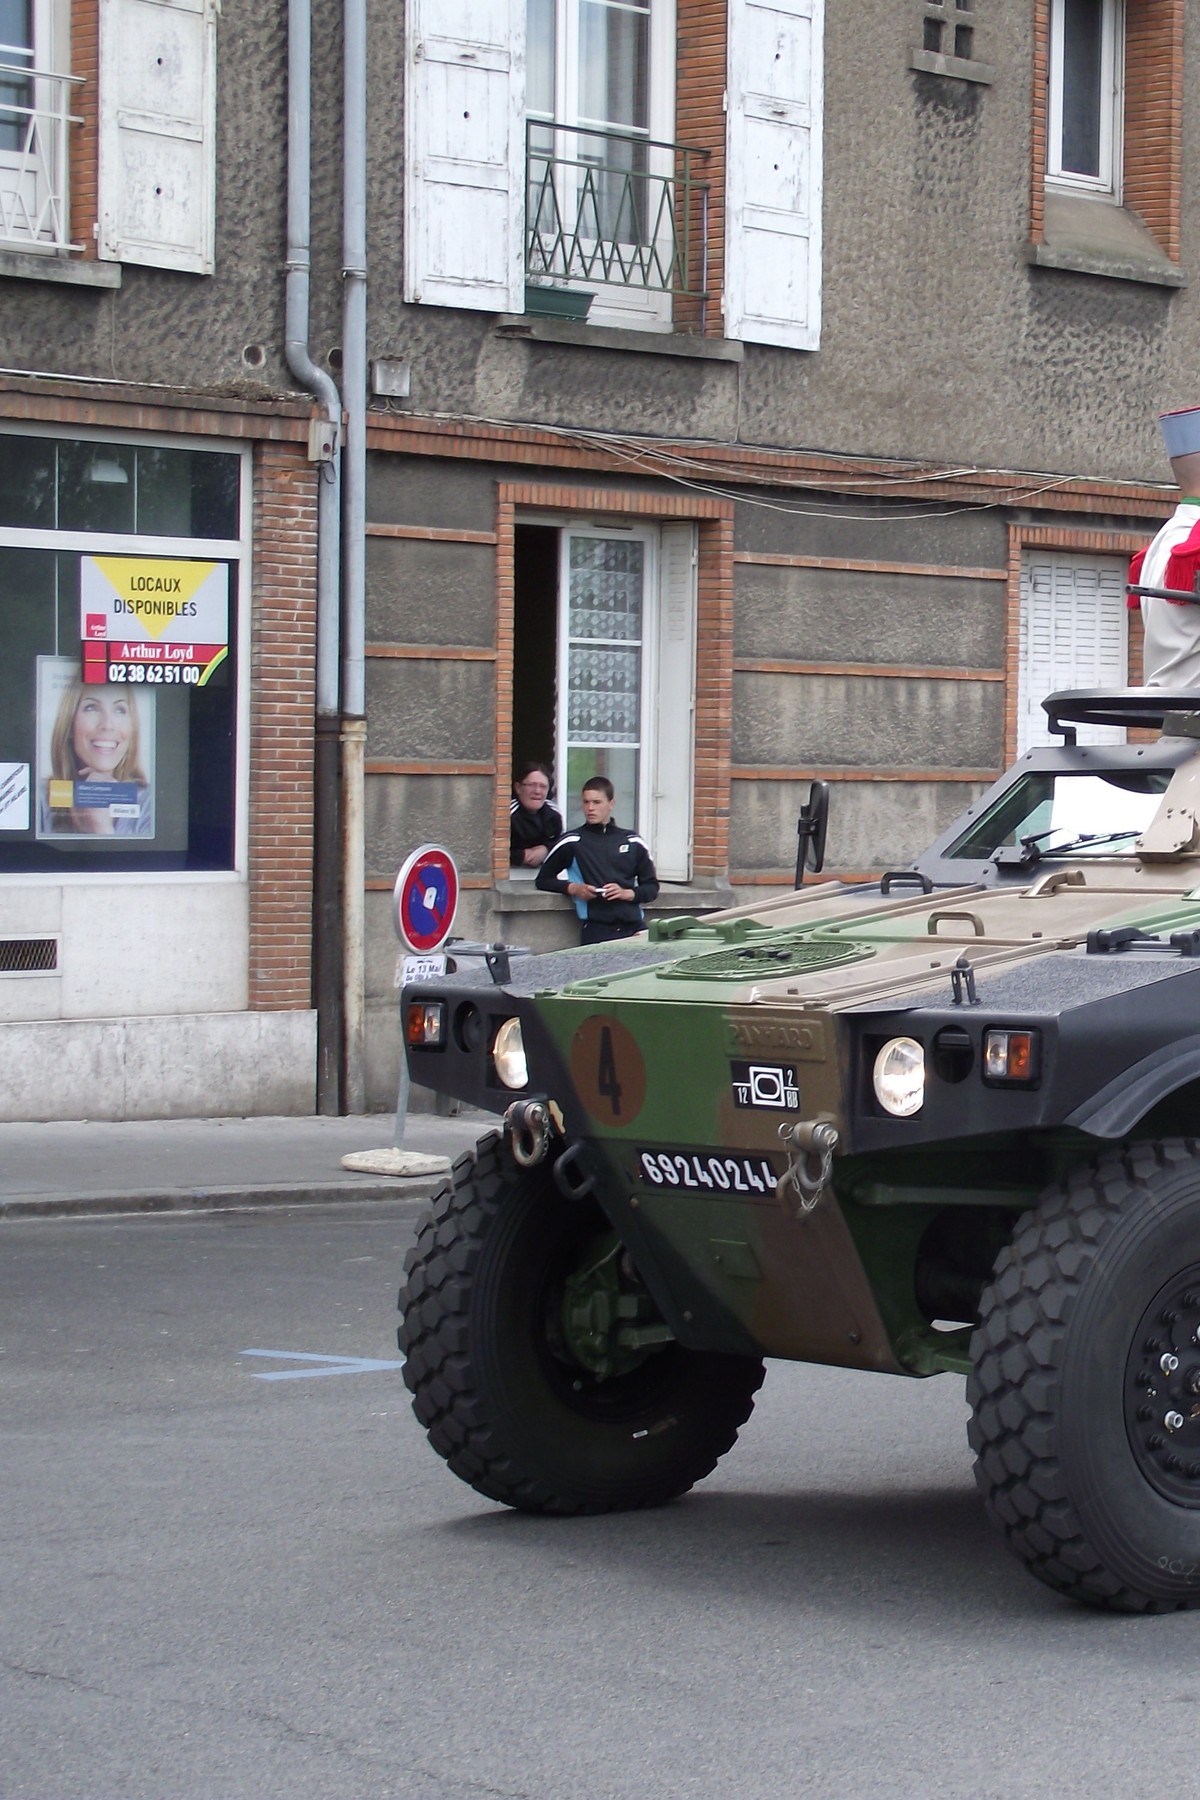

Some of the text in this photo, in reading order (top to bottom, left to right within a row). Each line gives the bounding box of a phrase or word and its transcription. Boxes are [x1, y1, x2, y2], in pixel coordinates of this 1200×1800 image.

[130, 576, 181, 593] LOCAUX
[114, 599, 197, 616] DISPONIBLES
[121, 643, 194, 663] Arthur Loyd
[109, 664, 199, 684] 02 38 62 51 00
[599, 1025, 622, 1116] 4
[787, 1069, 794, 1086] 2
[737, 1087, 748, 1104] 12
